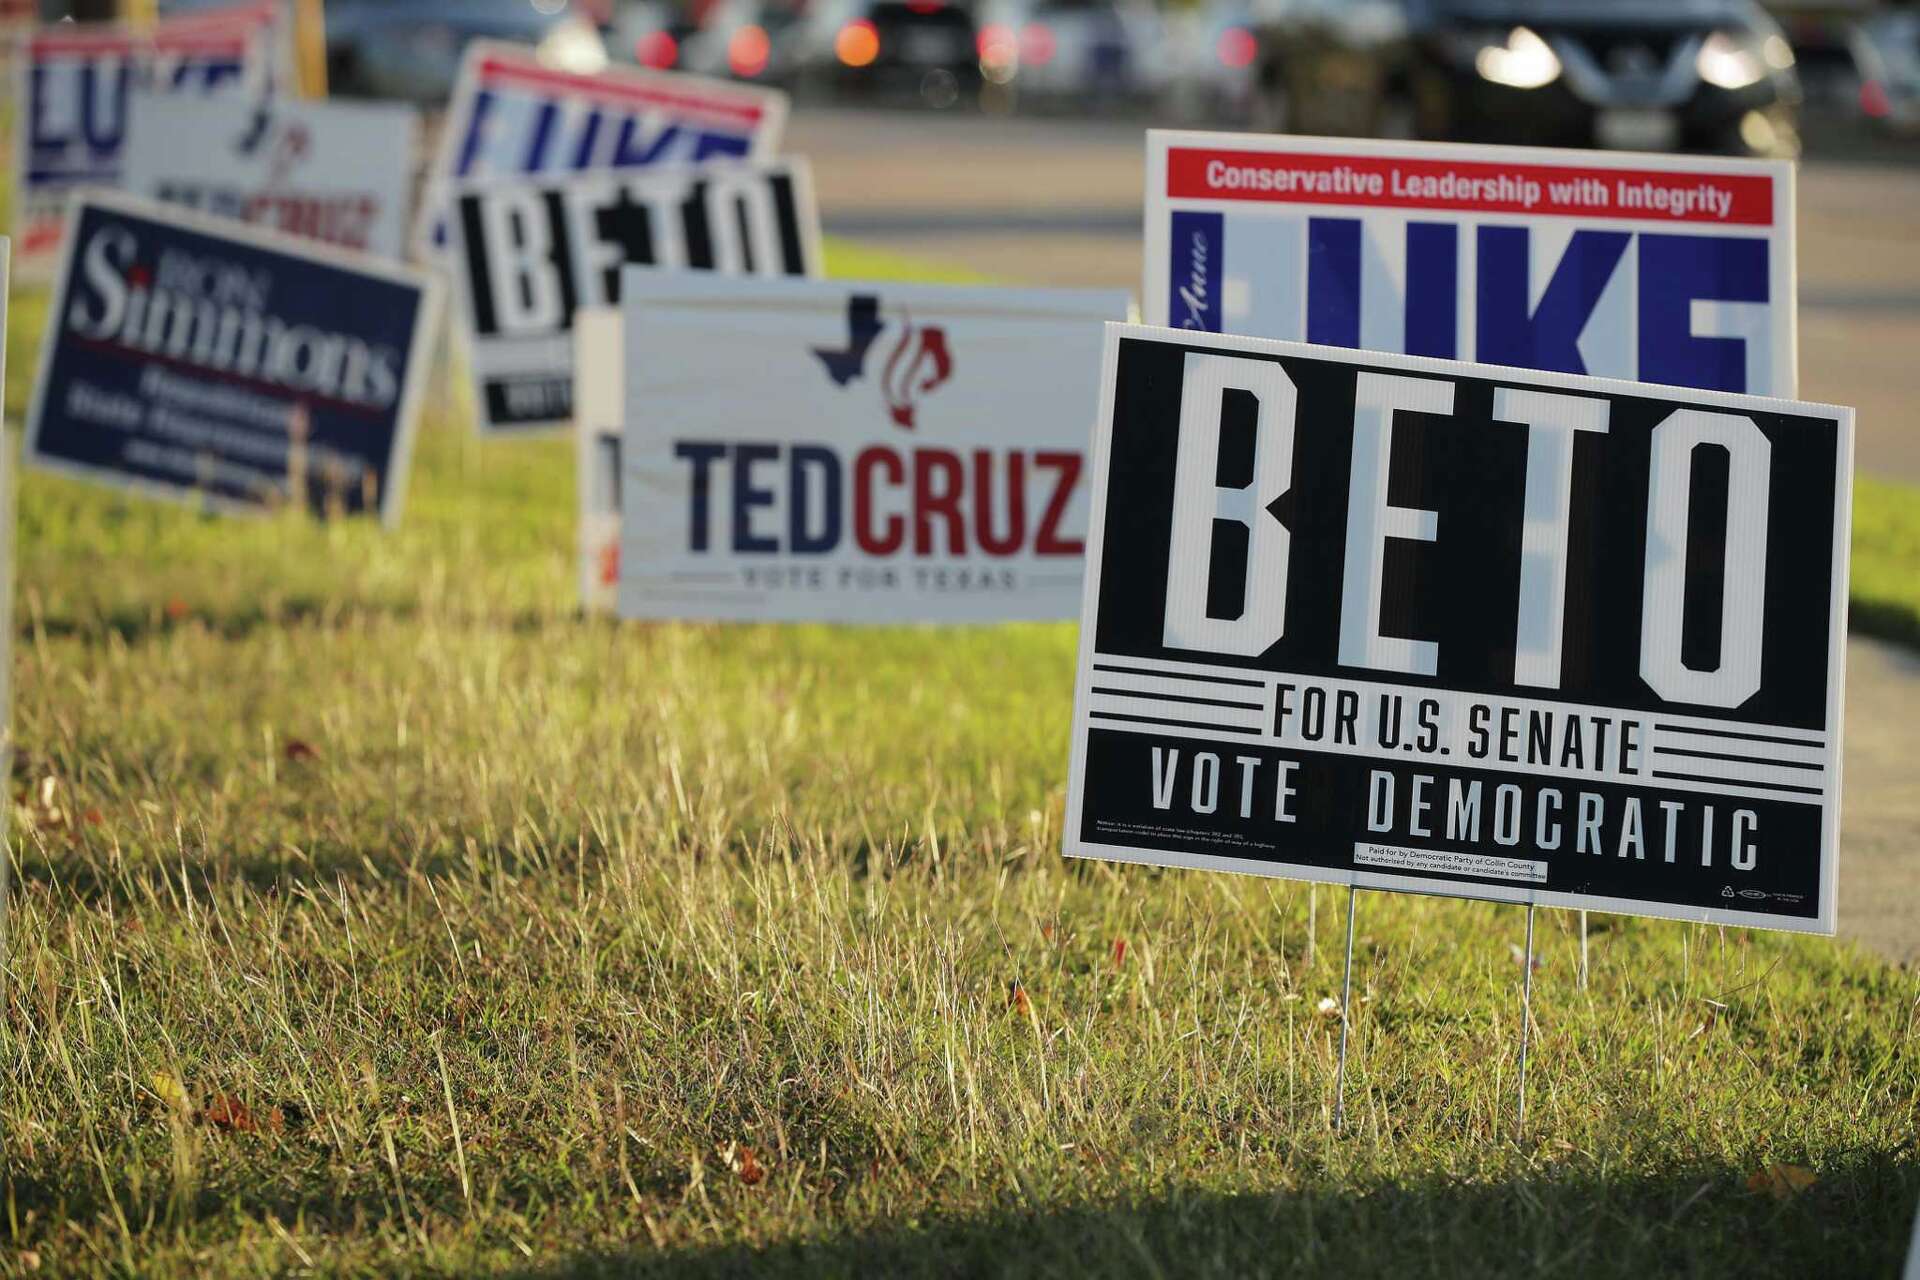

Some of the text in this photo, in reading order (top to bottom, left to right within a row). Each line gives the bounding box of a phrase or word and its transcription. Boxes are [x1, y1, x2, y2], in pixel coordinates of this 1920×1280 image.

[1206, 160, 1732, 217] Conservative Leadership with Integrity
[69, 224, 399, 407] Simmons
[1163, 352, 1771, 709] BETO
[742, 566, 1015, 592] VOTE FOR TEXAS
[1273, 683, 1639, 775] FOR U.S. SENATE
[1152, 747, 1757, 870] VOTE DEMOCRATIC
[1368, 846, 1385, 854] Paid
[1398, 850, 1408, 858] by
[1409, 851, 1452, 862] Democratic
[1453, 855, 1473, 865] Party
[1475, 857, 1482, 865] of
[1484, 858, 1506, 867] Collin
[1429, 862, 1461, 871] candidate
